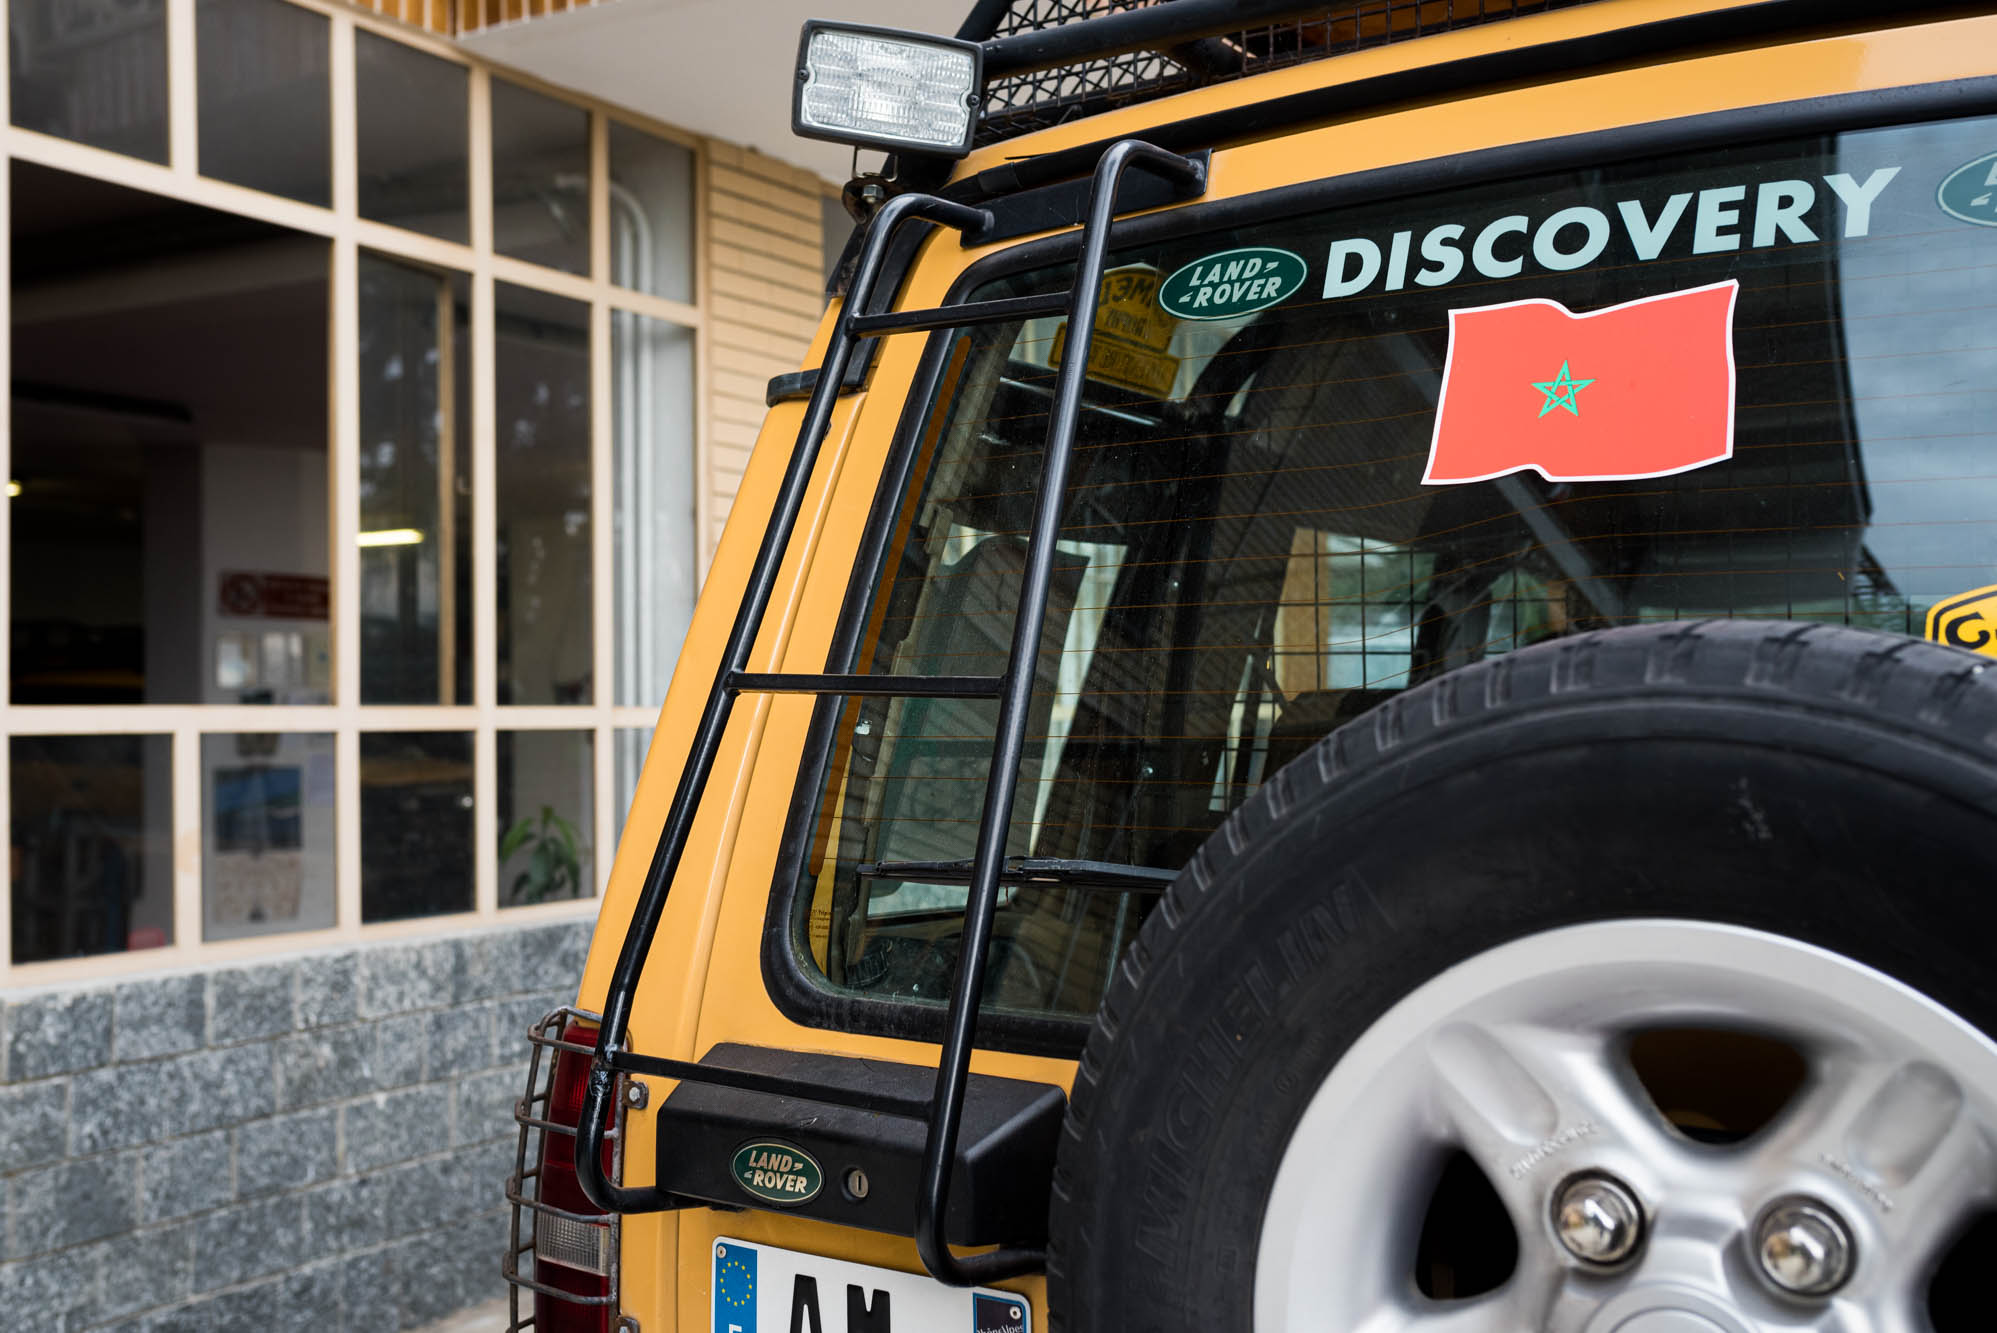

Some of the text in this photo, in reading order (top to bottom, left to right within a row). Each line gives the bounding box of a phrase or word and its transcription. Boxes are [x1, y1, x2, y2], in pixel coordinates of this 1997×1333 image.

[1322, 166, 1902, 299] DISCOVERY
[1189, 257, 1263, 287] LAND
[1192, 276, 1283, 309] ROVER
[1135, 883, 1364, 1263] MICHELIN
[749, 1150, 793, 1173] LAND
[753, 1169, 808, 1194] ROVER
